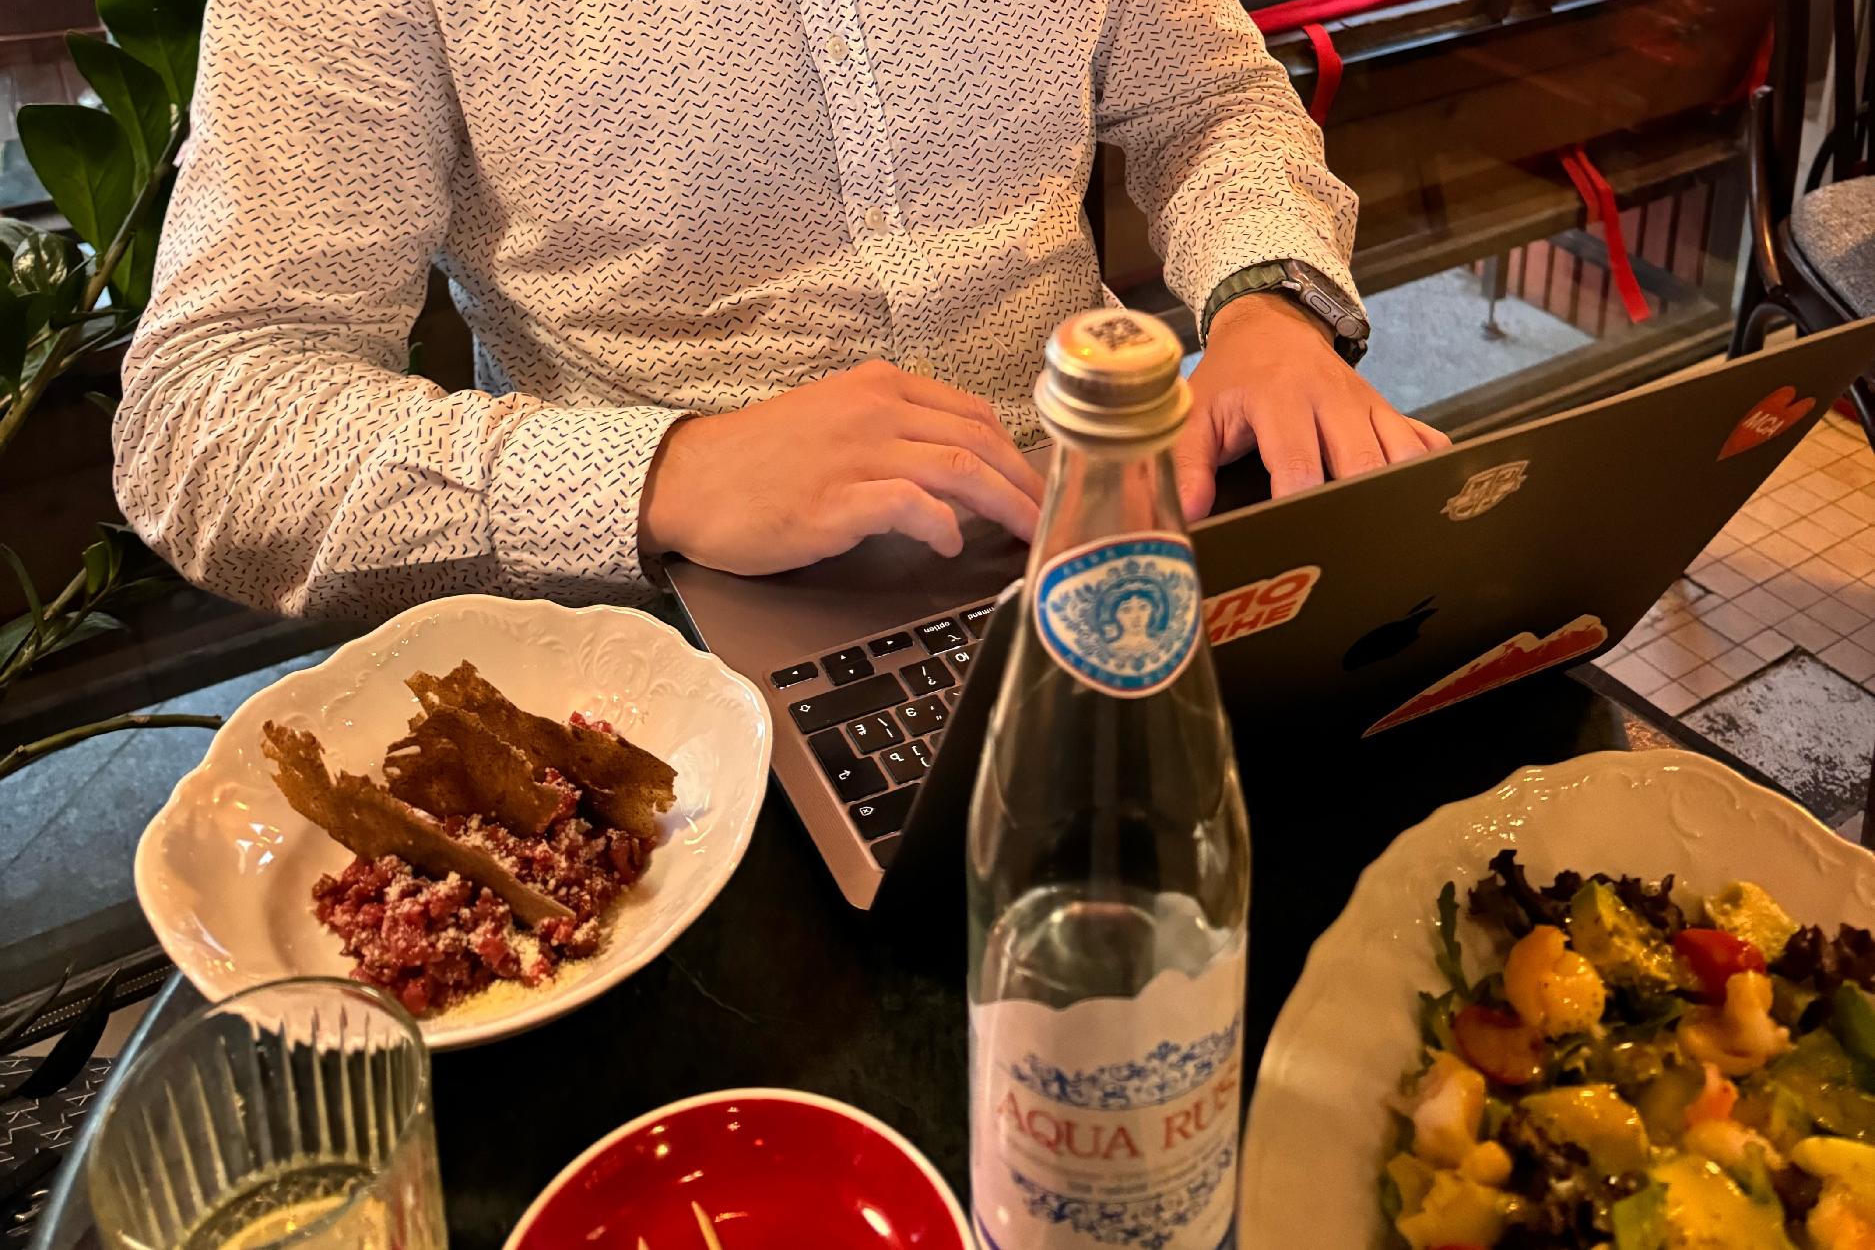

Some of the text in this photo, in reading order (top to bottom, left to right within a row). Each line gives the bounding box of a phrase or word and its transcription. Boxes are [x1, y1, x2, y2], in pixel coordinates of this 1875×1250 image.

[923, 621, 950, 633] option
[954, 651, 970, 662] Ю
[997, 1091, 1141, 1160] AQUA
